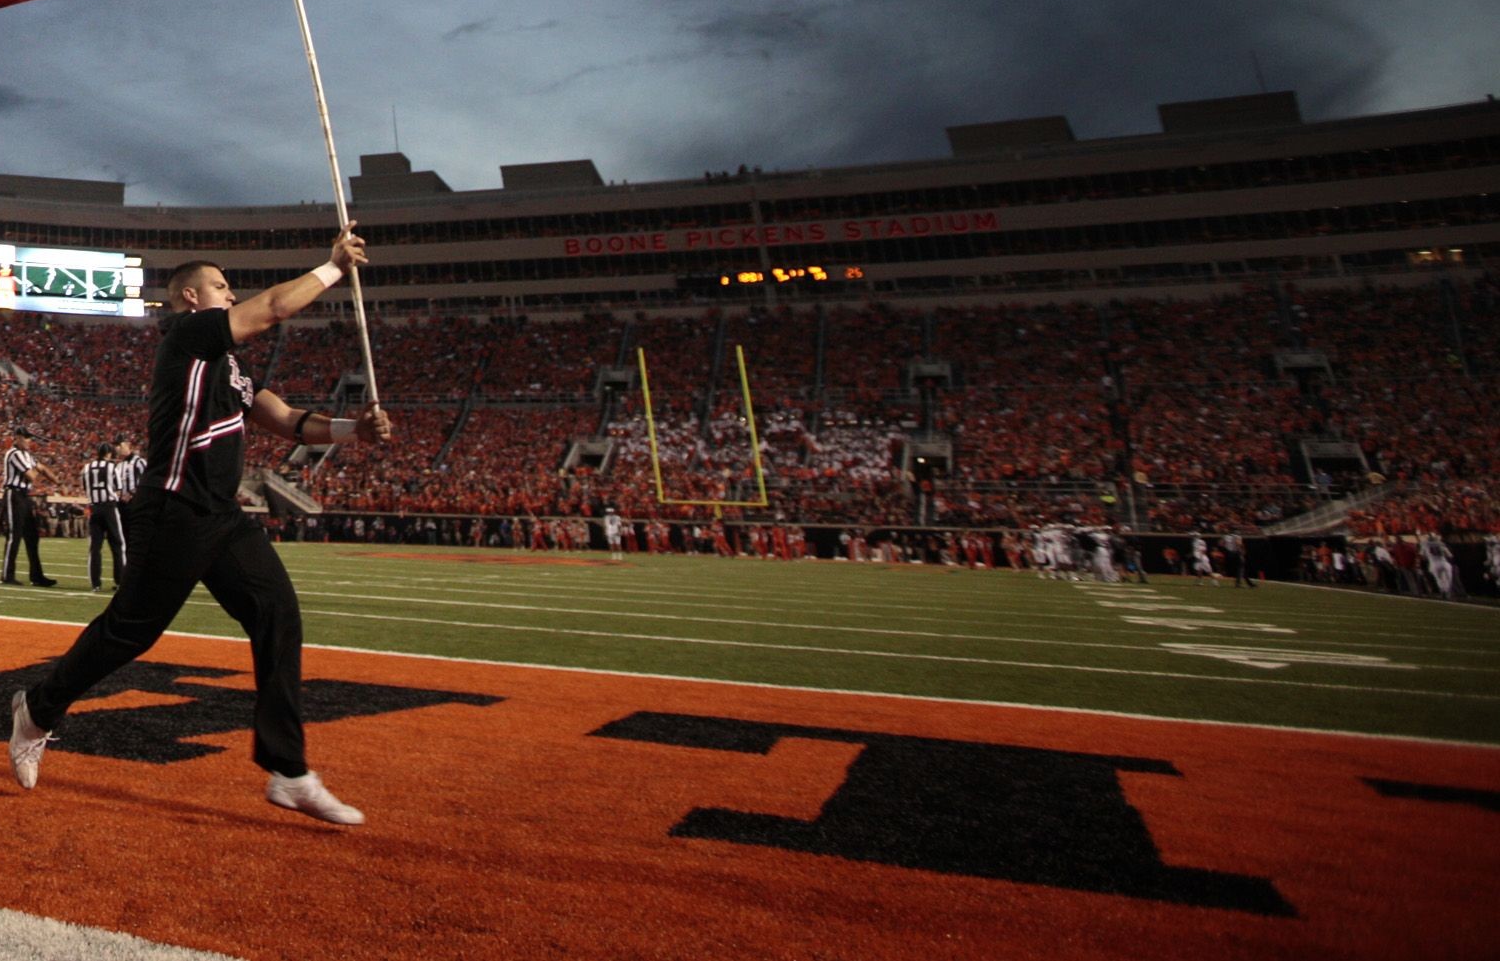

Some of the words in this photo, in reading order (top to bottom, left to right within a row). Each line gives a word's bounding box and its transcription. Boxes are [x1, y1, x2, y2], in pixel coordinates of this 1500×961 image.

[564, 232, 668, 255] BOONE
[685, 221, 826, 248] PICKENS
[843, 211, 1000, 240] STADIUM
